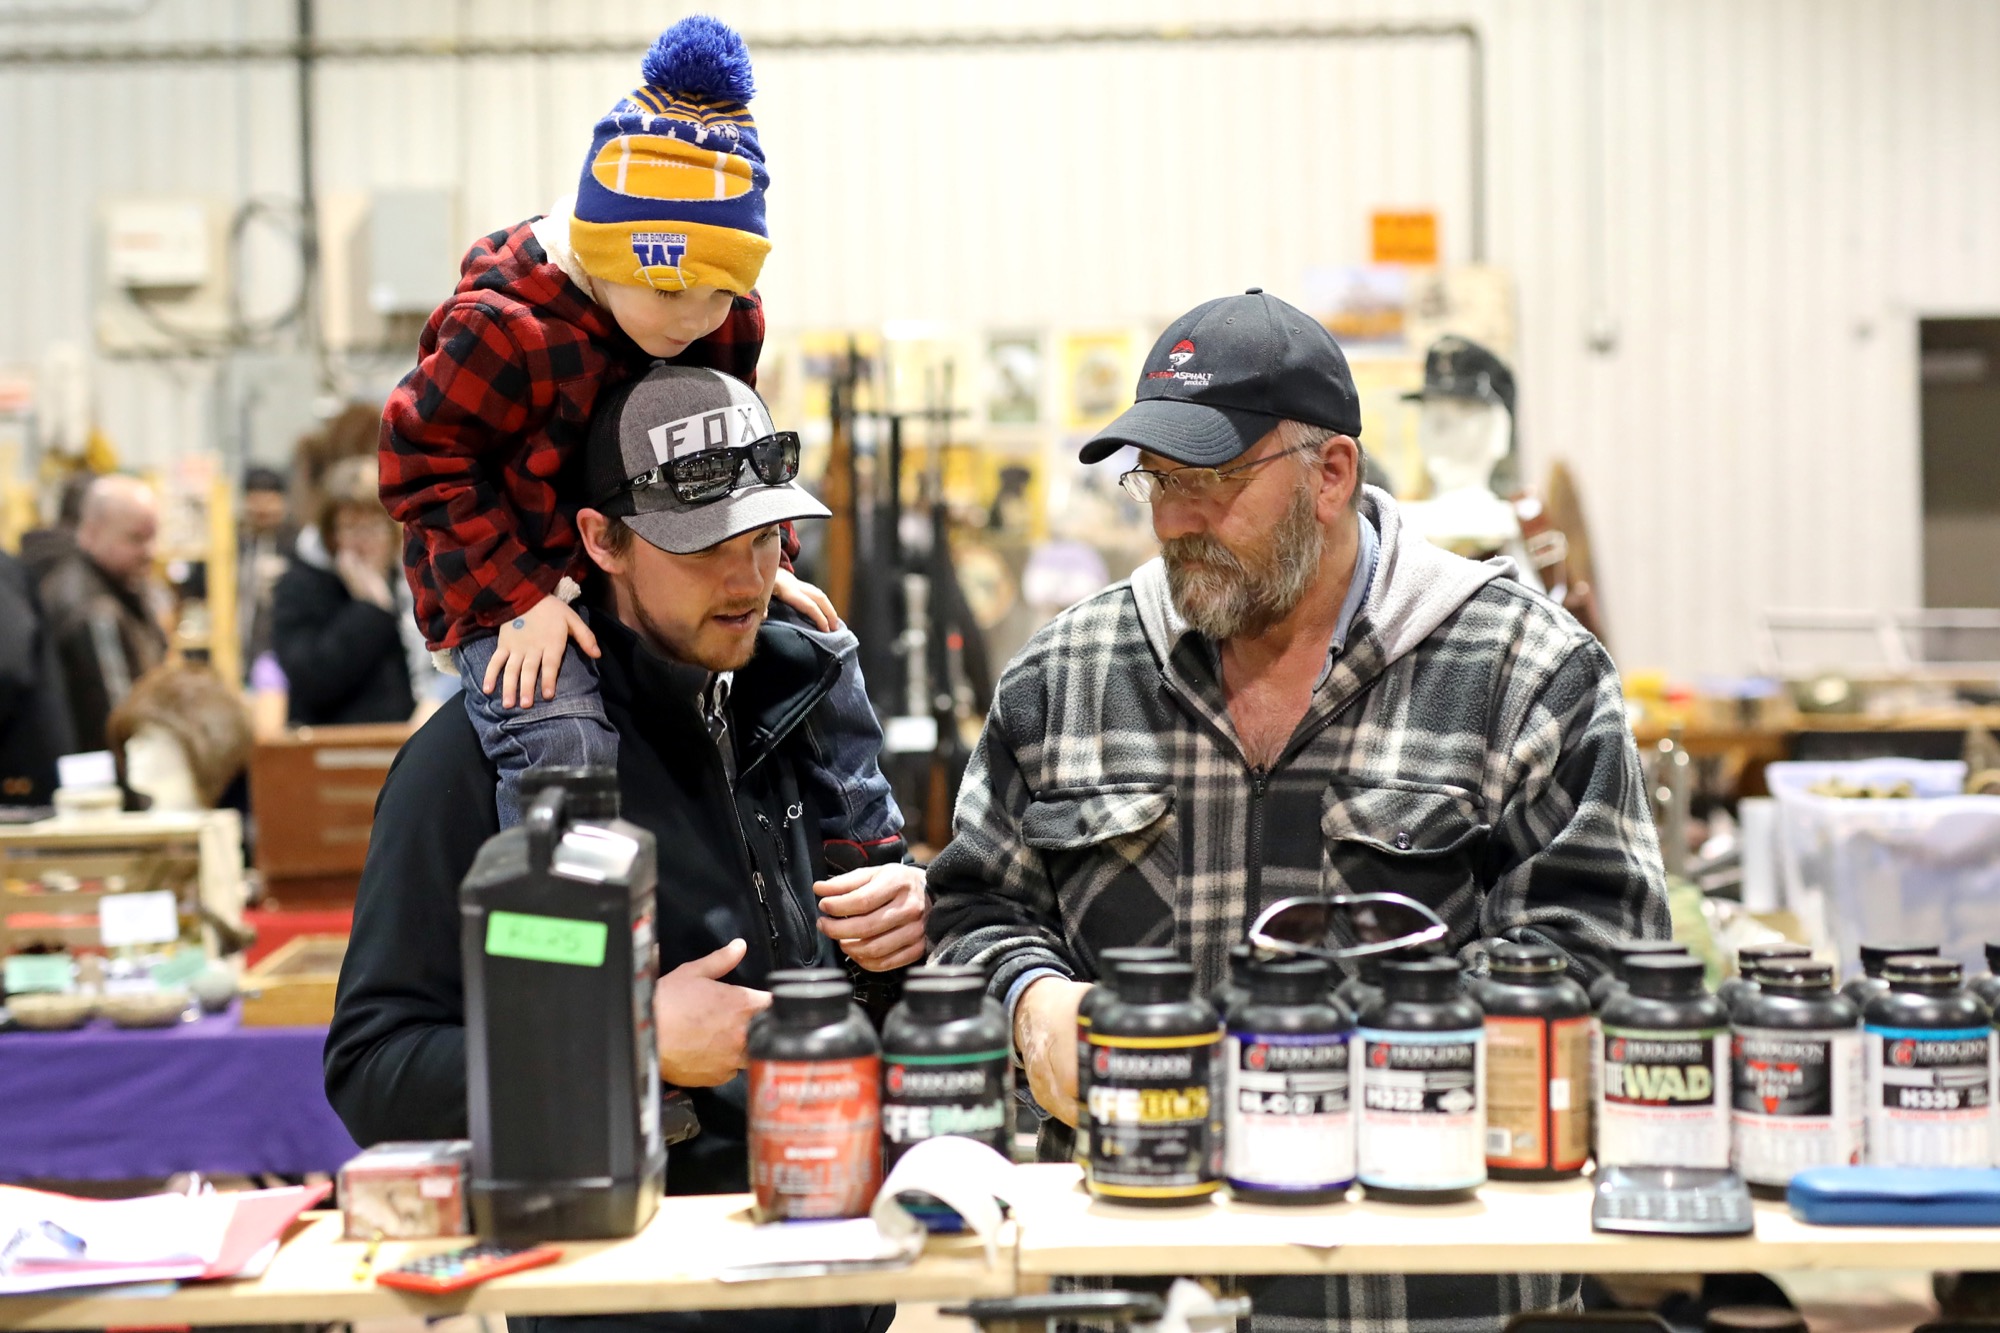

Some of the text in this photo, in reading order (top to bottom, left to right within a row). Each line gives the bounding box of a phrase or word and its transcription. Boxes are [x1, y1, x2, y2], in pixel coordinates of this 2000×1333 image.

[632, 233, 686, 243] BLUE BOMBERS
[1173, 371, 1213, 380] ASPHALT
[665, 407, 757, 460] FOX
[1627, 1041, 1703, 1058] HODGDON
[1899, 1087, 1960, 1109] H335
